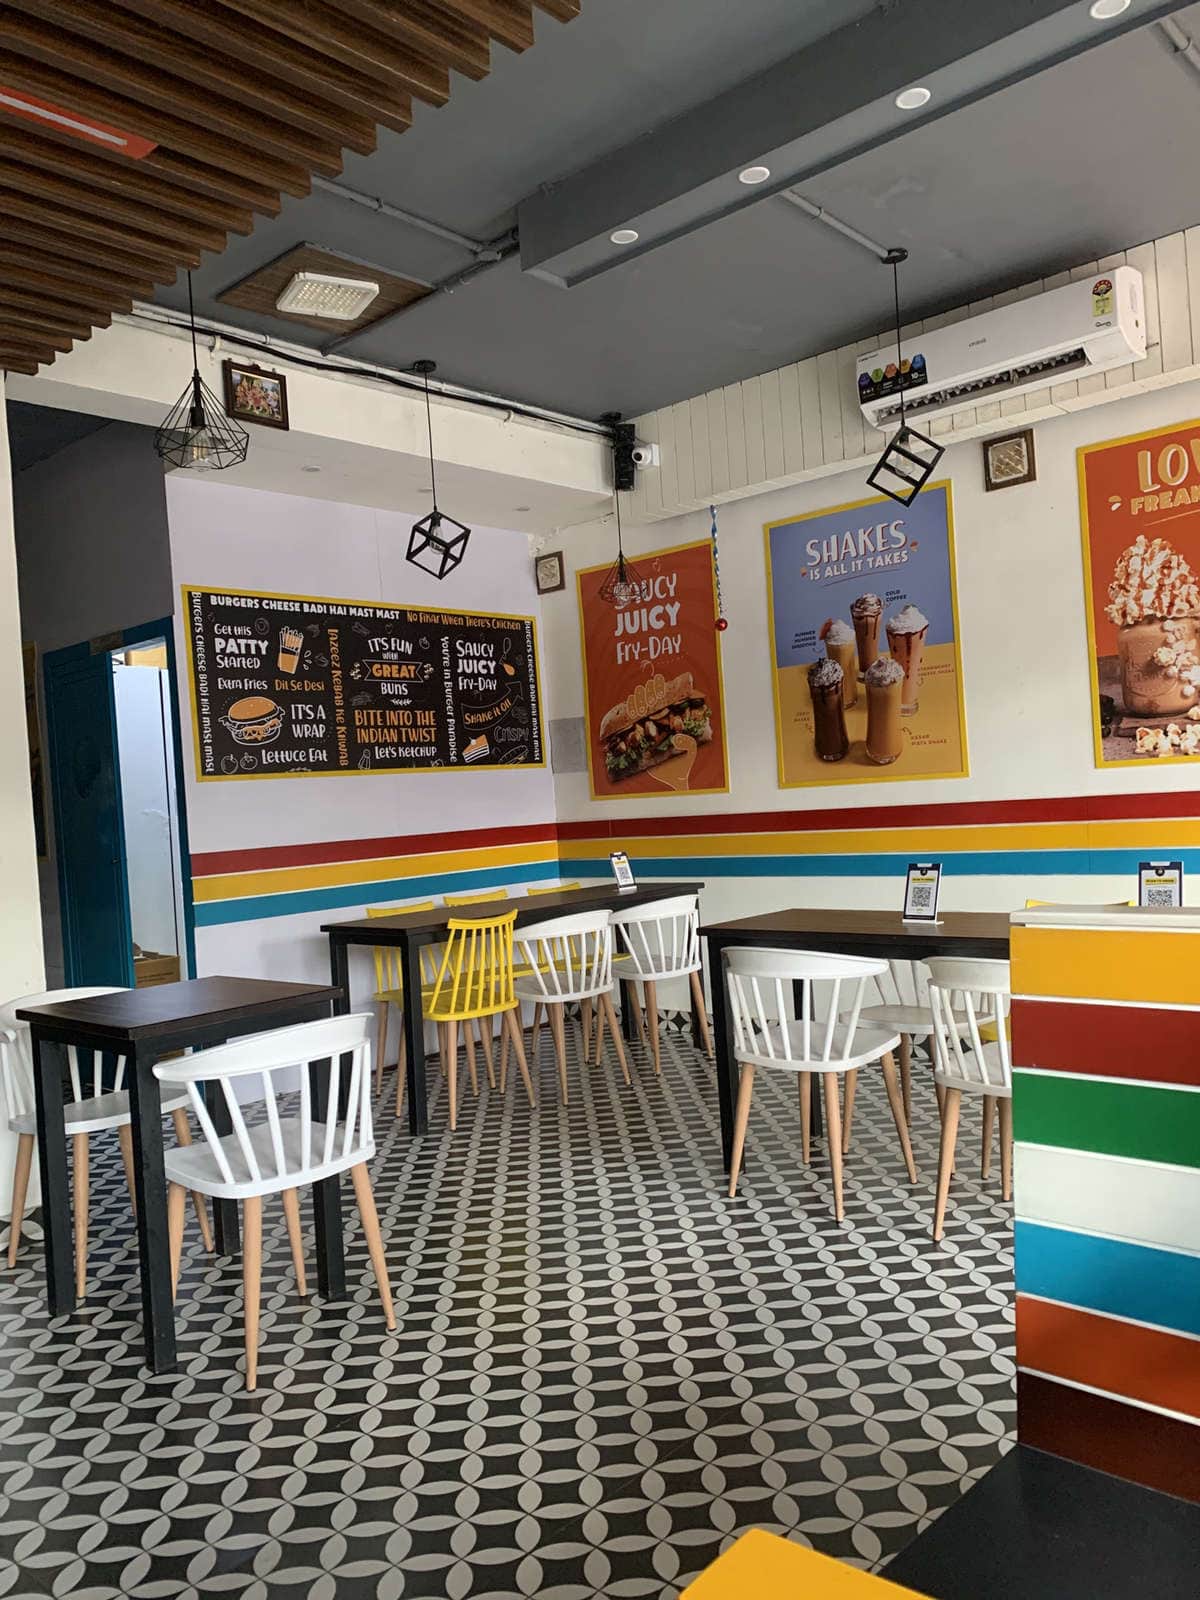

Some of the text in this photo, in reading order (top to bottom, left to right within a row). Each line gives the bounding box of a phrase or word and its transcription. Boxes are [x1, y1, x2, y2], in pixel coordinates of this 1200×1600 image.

[806, 519, 907, 567] SHAKES
[810, 550, 909, 580] IS ALL IT TAKES
[210, 595, 400, 620] BURGERS CHEESE BADI HAI MAST MAST
[614, 601, 680, 636] JUICY
[214, 624, 232, 635] Get
[214, 637, 268, 655] PATTY
[390, 637, 413, 655] FUN
[455, 639, 494, 658] SAUCY
[372, 664, 417, 678] GREAT
[456, 659, 496, 675] JUICY
[290, 679, 302, 691] Se
[316, 704, 326, 720] A
[354, 710, 437, 726] BITE INTO THE
[292, 724, 326, 738] WRAP
[356, 727, 437, 744] INDIAN TWIST
